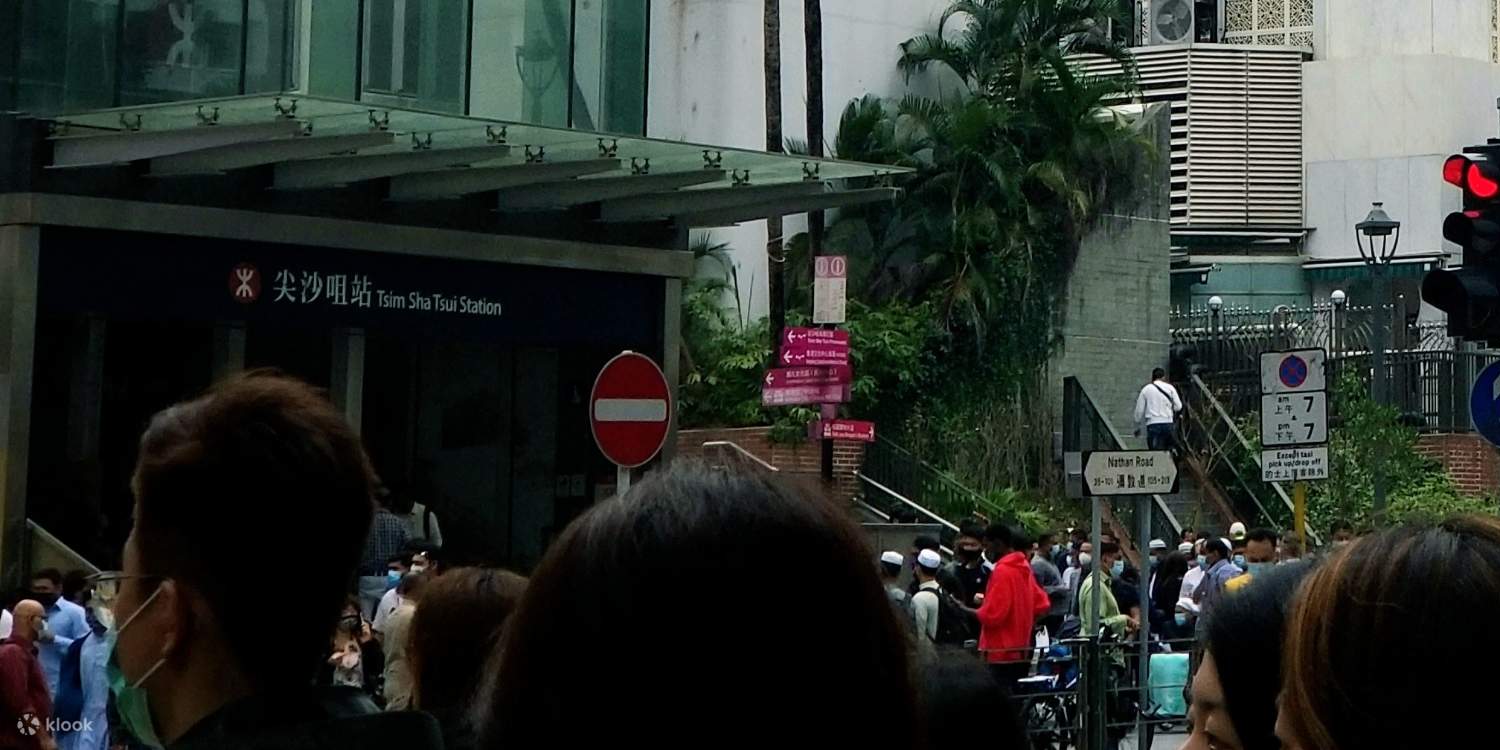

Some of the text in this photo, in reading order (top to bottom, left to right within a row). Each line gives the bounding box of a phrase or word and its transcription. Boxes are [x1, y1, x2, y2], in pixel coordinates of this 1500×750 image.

[273, 269, 372, 308] 尖沙咀站
[377, 290, 502, 316] Tsim Sha Tsui Station
[1274, 405, 1293, 416] 上午
[1303, 396, 1314, 413] 7
[1275, 431, 1293, 441] 下午
[1278, 422, 1315, 440] pm 7
[1301, 450, 1313, 458] taxi
[1108, 456, 1154, 468] Nathan Road
[1269, 460, 1282, 469] pick
